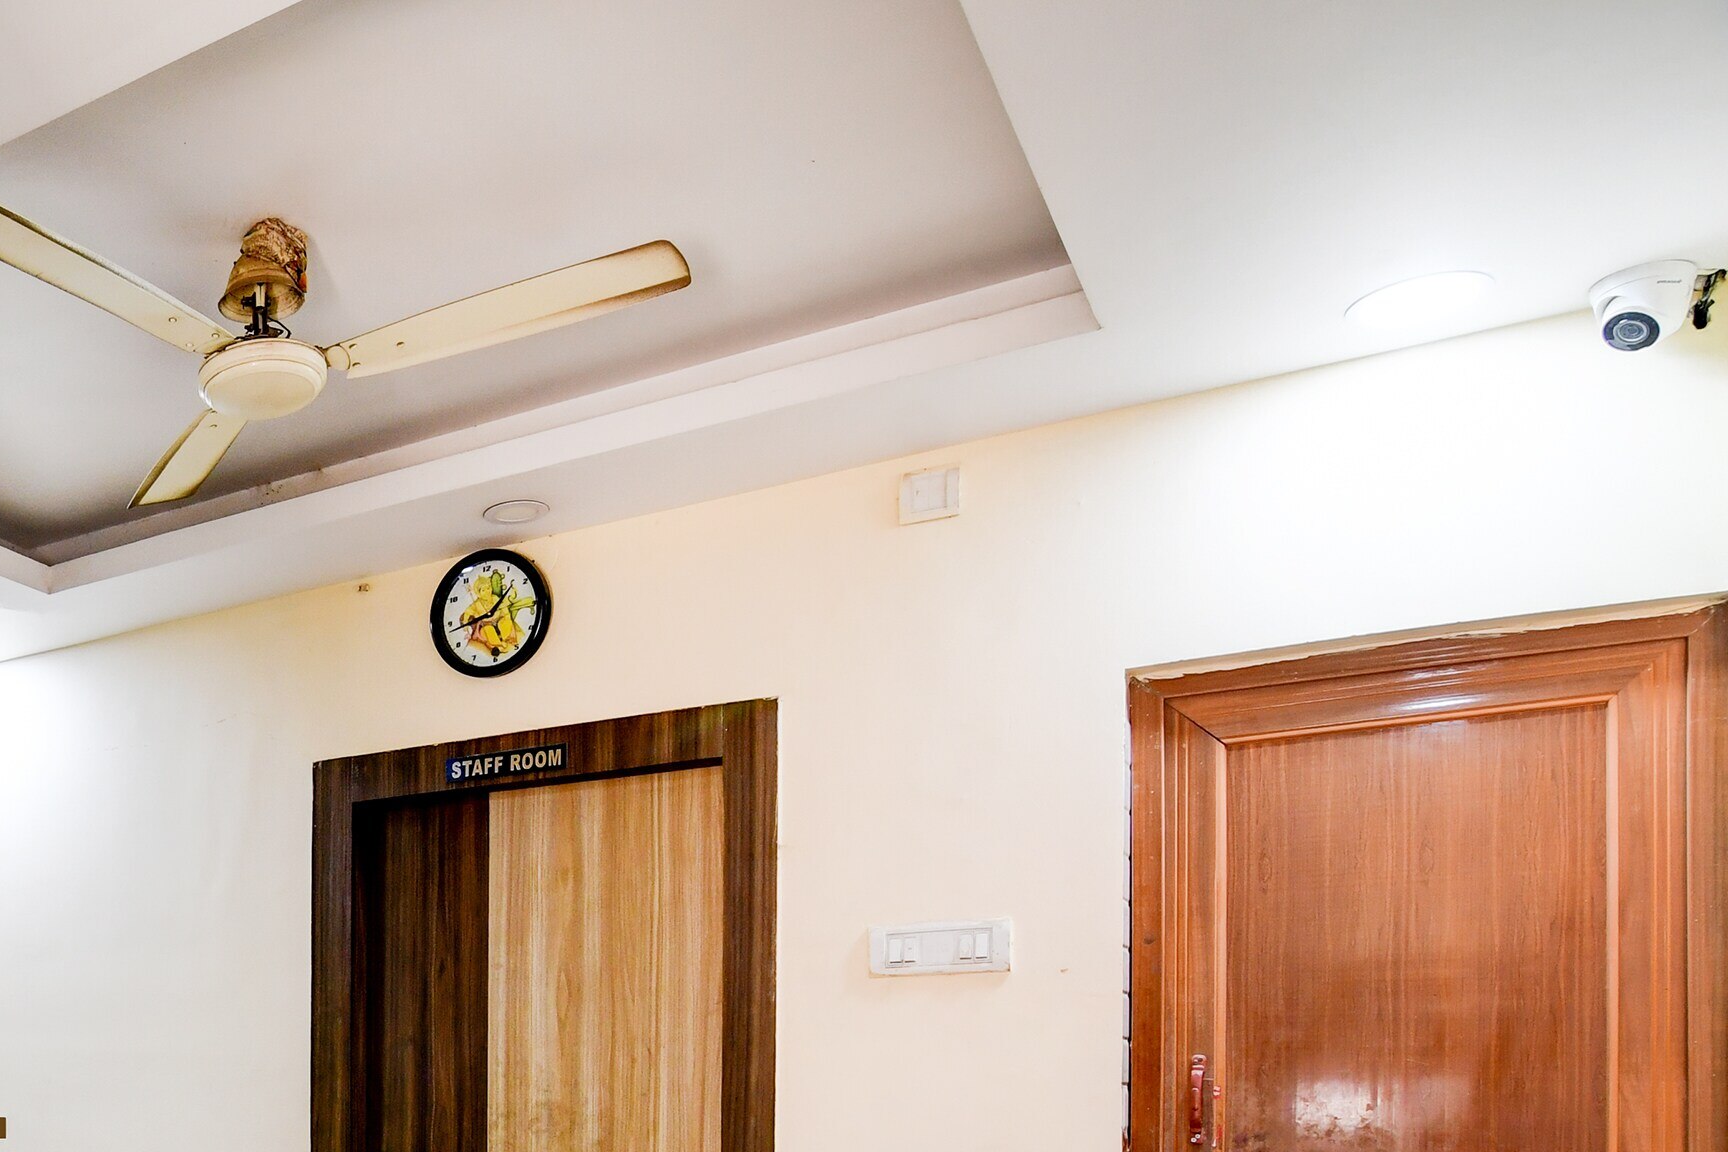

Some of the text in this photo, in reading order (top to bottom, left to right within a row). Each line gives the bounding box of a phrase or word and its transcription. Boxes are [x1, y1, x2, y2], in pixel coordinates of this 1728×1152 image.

[482, 565, 491, 573] 12
[451, 749, 562, 779] STAFF ROOM
